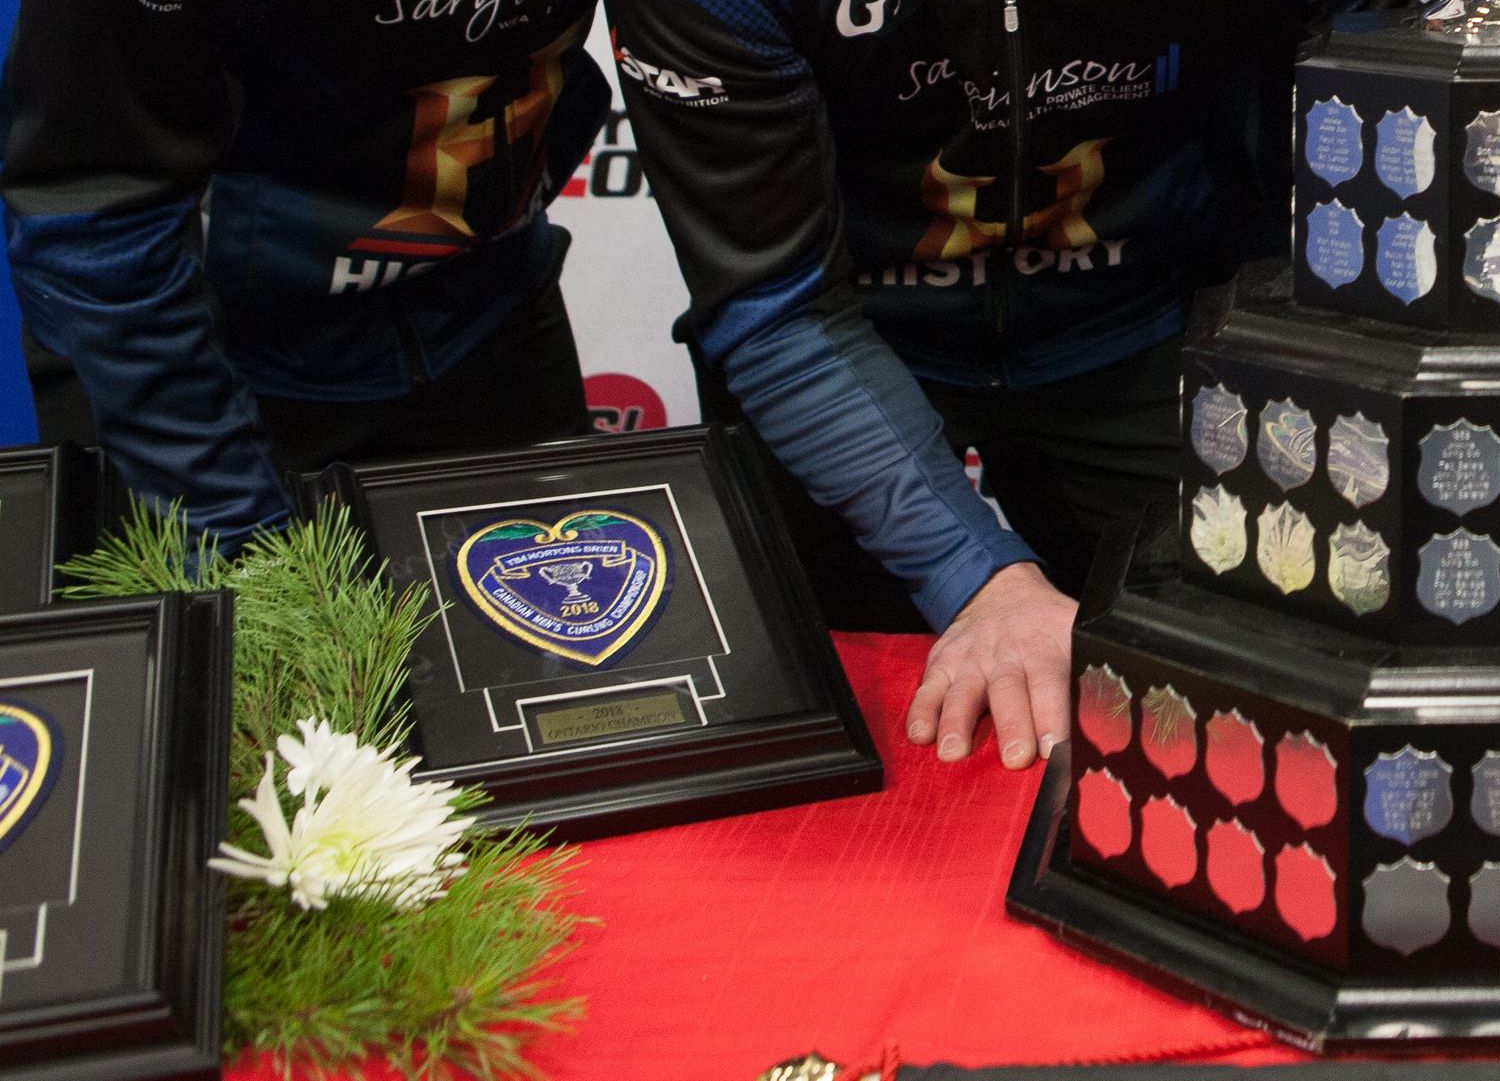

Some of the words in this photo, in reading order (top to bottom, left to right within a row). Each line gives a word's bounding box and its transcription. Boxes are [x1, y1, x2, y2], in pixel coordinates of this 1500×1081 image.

[1046, 84, 1097, 105] PRIVATE
[1101, 81, 1151, 95] CLIENT
[591, 150, 655, 198] O
[527, 545, 582, 562] HORTONS
[582, 544, 618, 555] BRIER
[492, 588, 534, 619] CANADIAN
[531, 614, 563, 633] MEN'S
[560, 601, 600, 618] 2018
